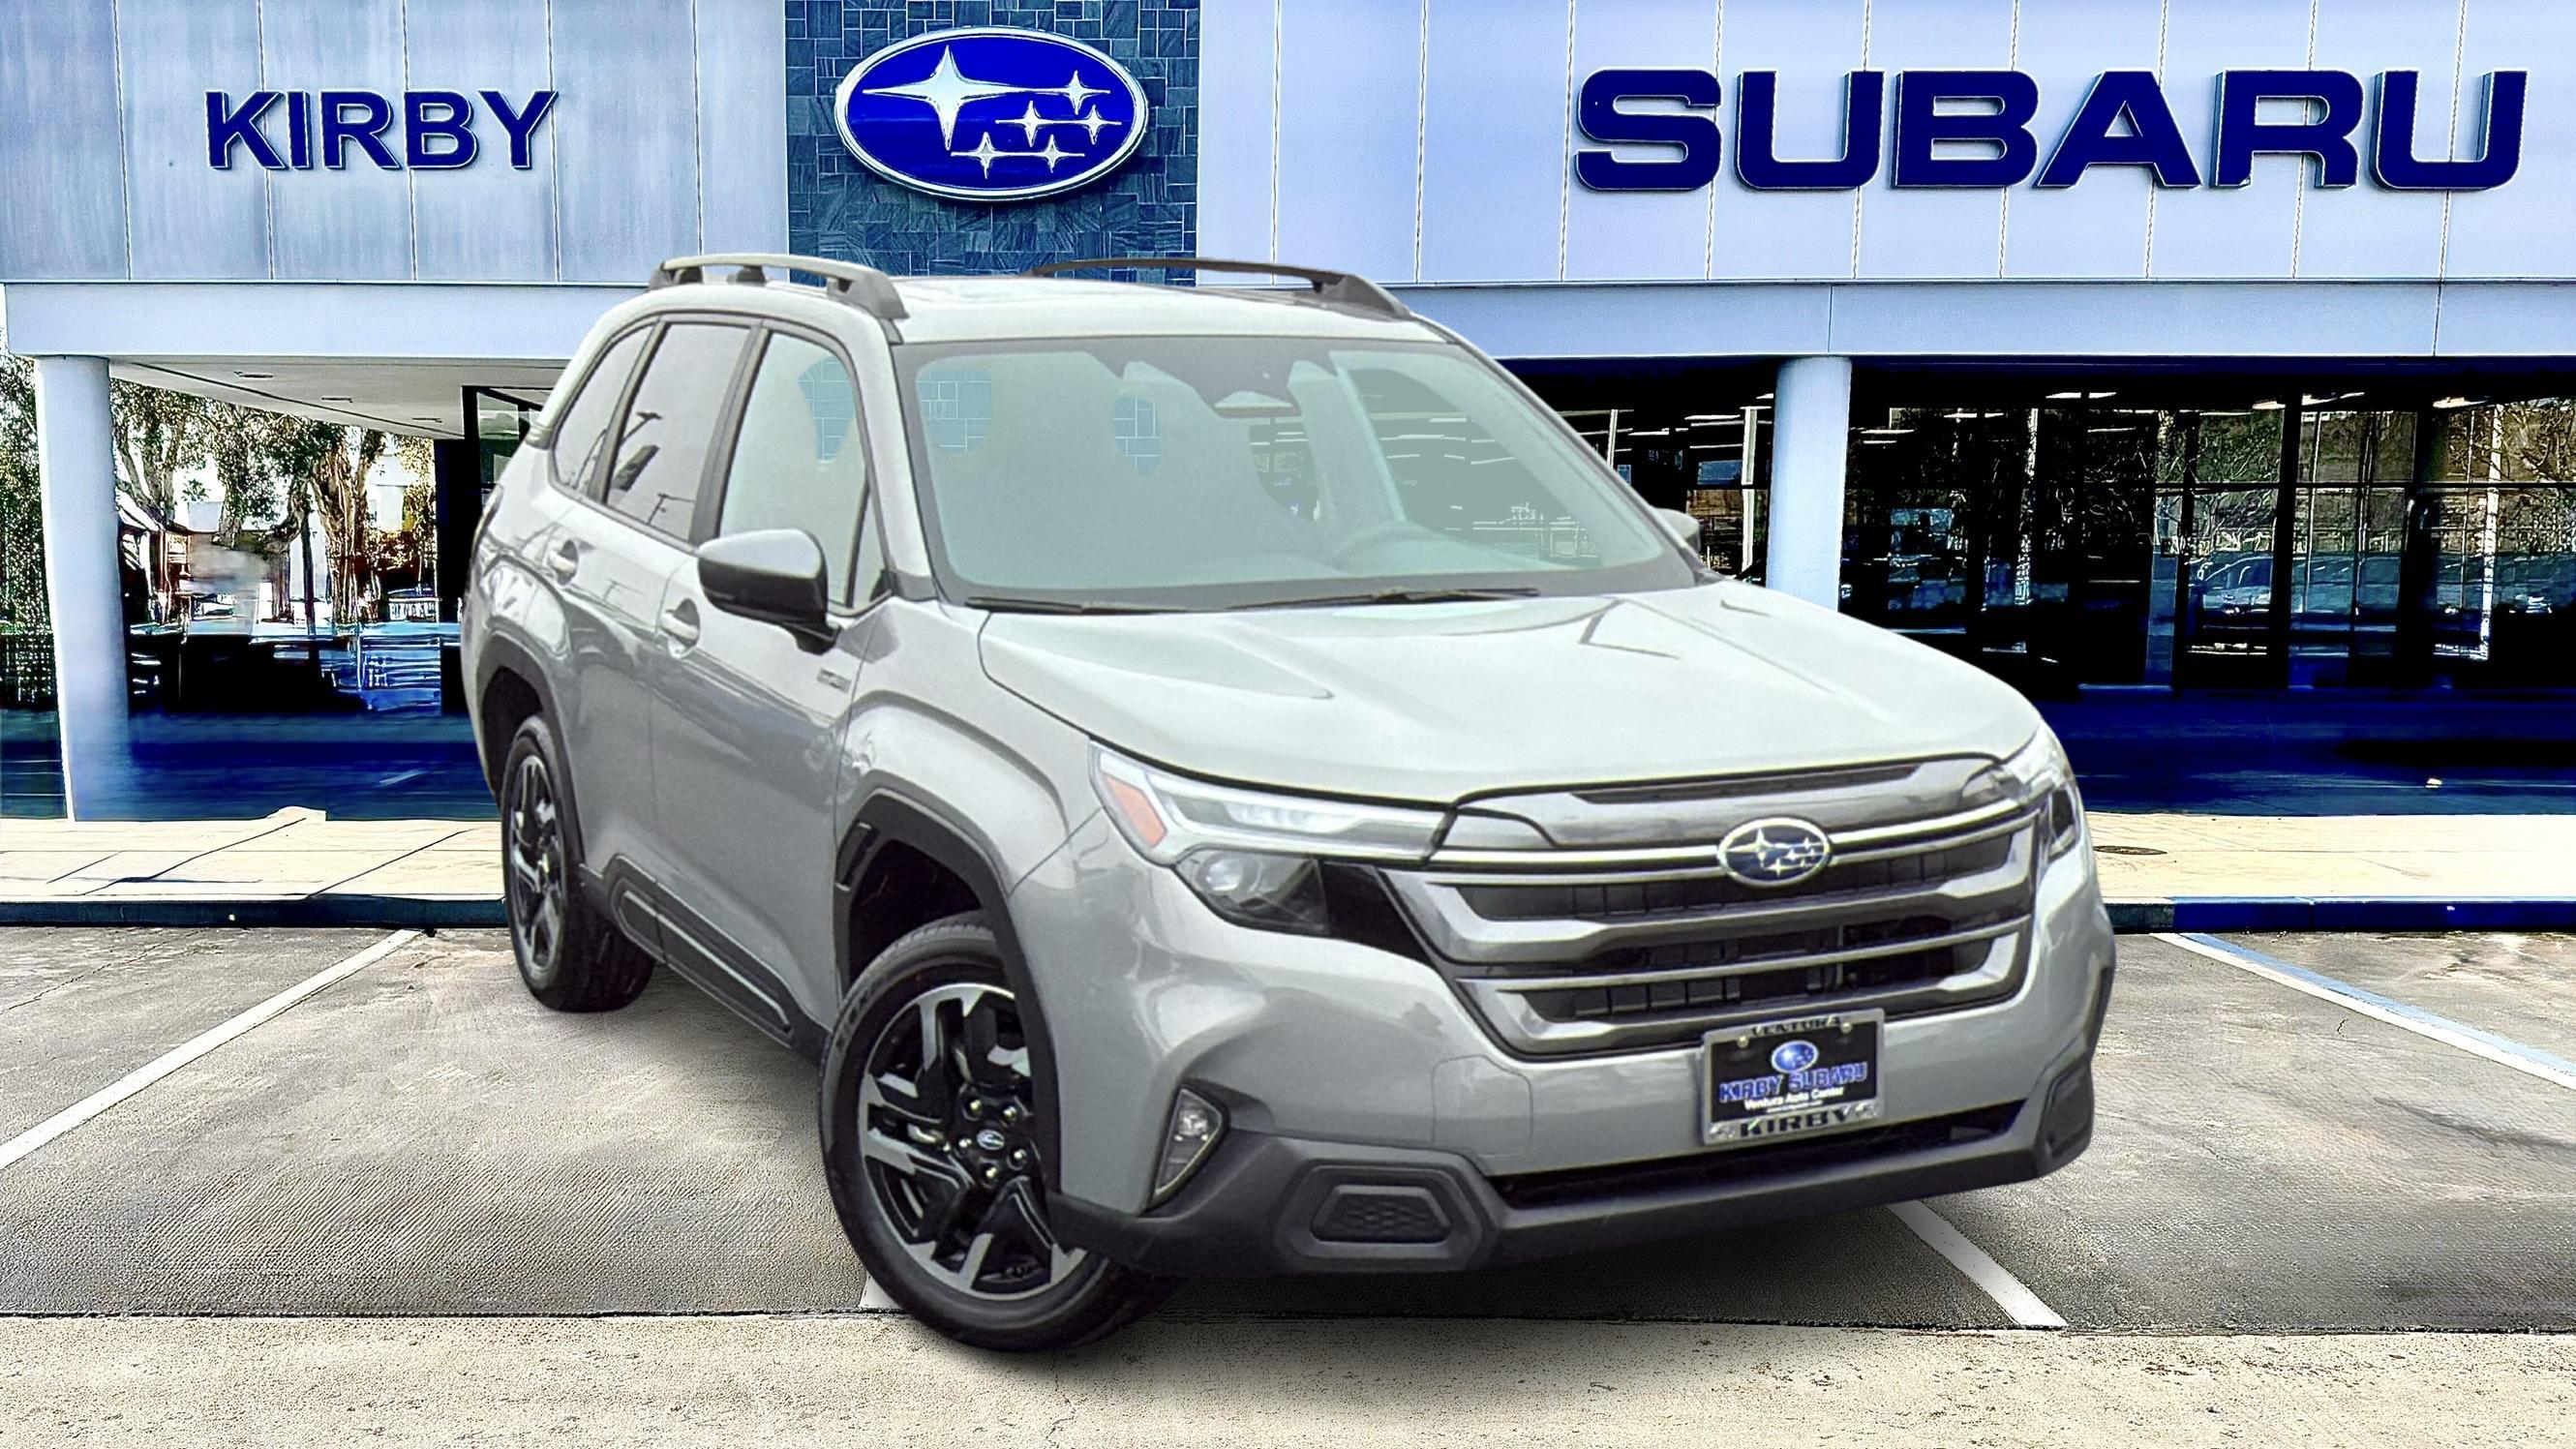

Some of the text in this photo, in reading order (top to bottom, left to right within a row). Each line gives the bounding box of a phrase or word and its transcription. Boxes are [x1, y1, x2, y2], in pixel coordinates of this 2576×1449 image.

[205, 91, 557, 170] KIRBY
[1575, 70, 2528, 192] SUBARU
[1719, 1062, 1868, 1102] KIRBY SUBARU
[1740, 1110, 1851, 1137] KIRBY
